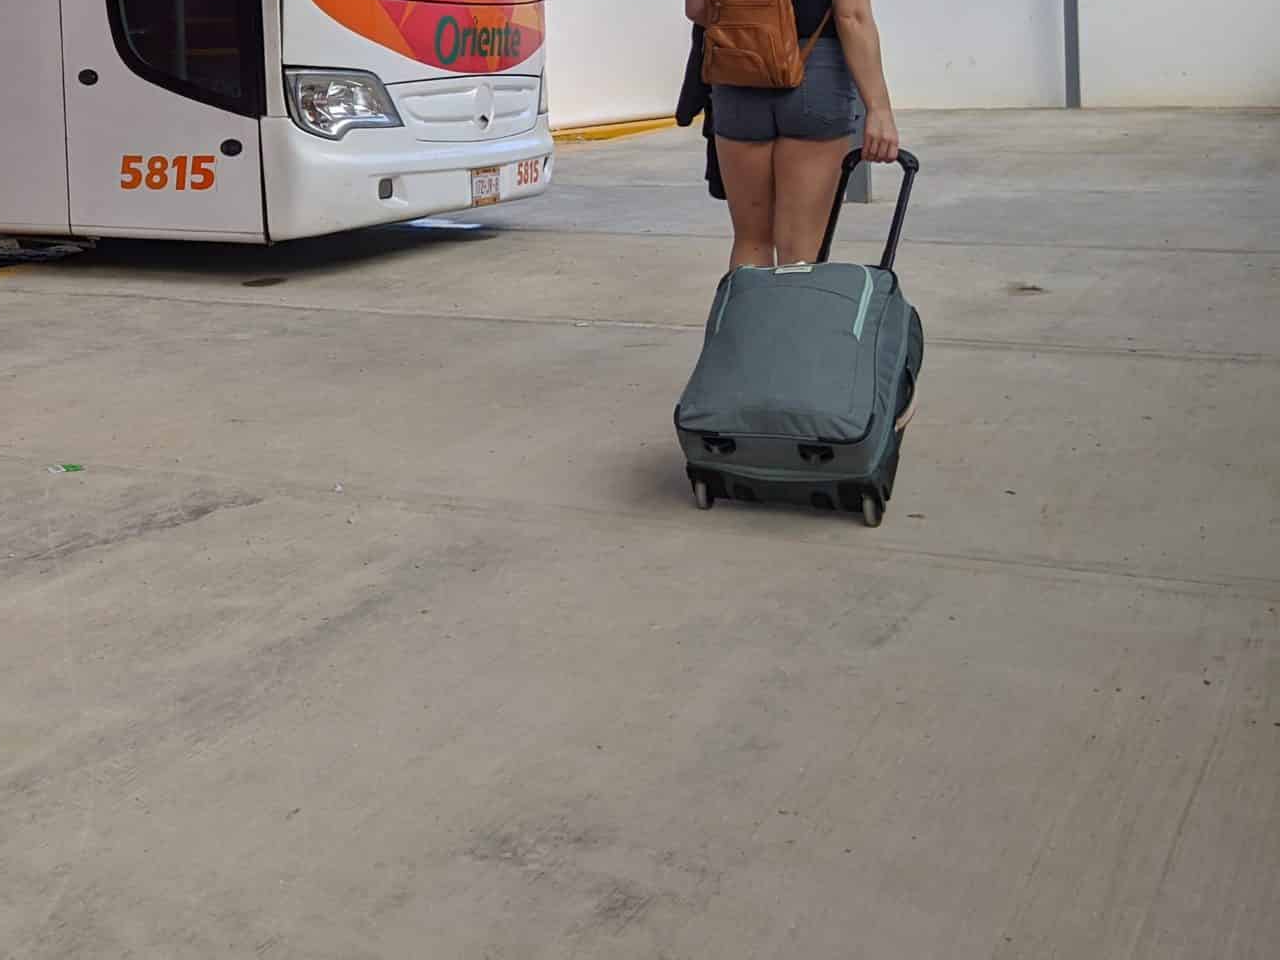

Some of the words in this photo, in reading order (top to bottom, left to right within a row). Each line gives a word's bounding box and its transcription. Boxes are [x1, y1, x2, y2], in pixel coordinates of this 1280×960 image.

[434, 15, 521, 65] Oriente
[120, 154, 216, 191] 5815
[517, 159, 540, 186] 5815
